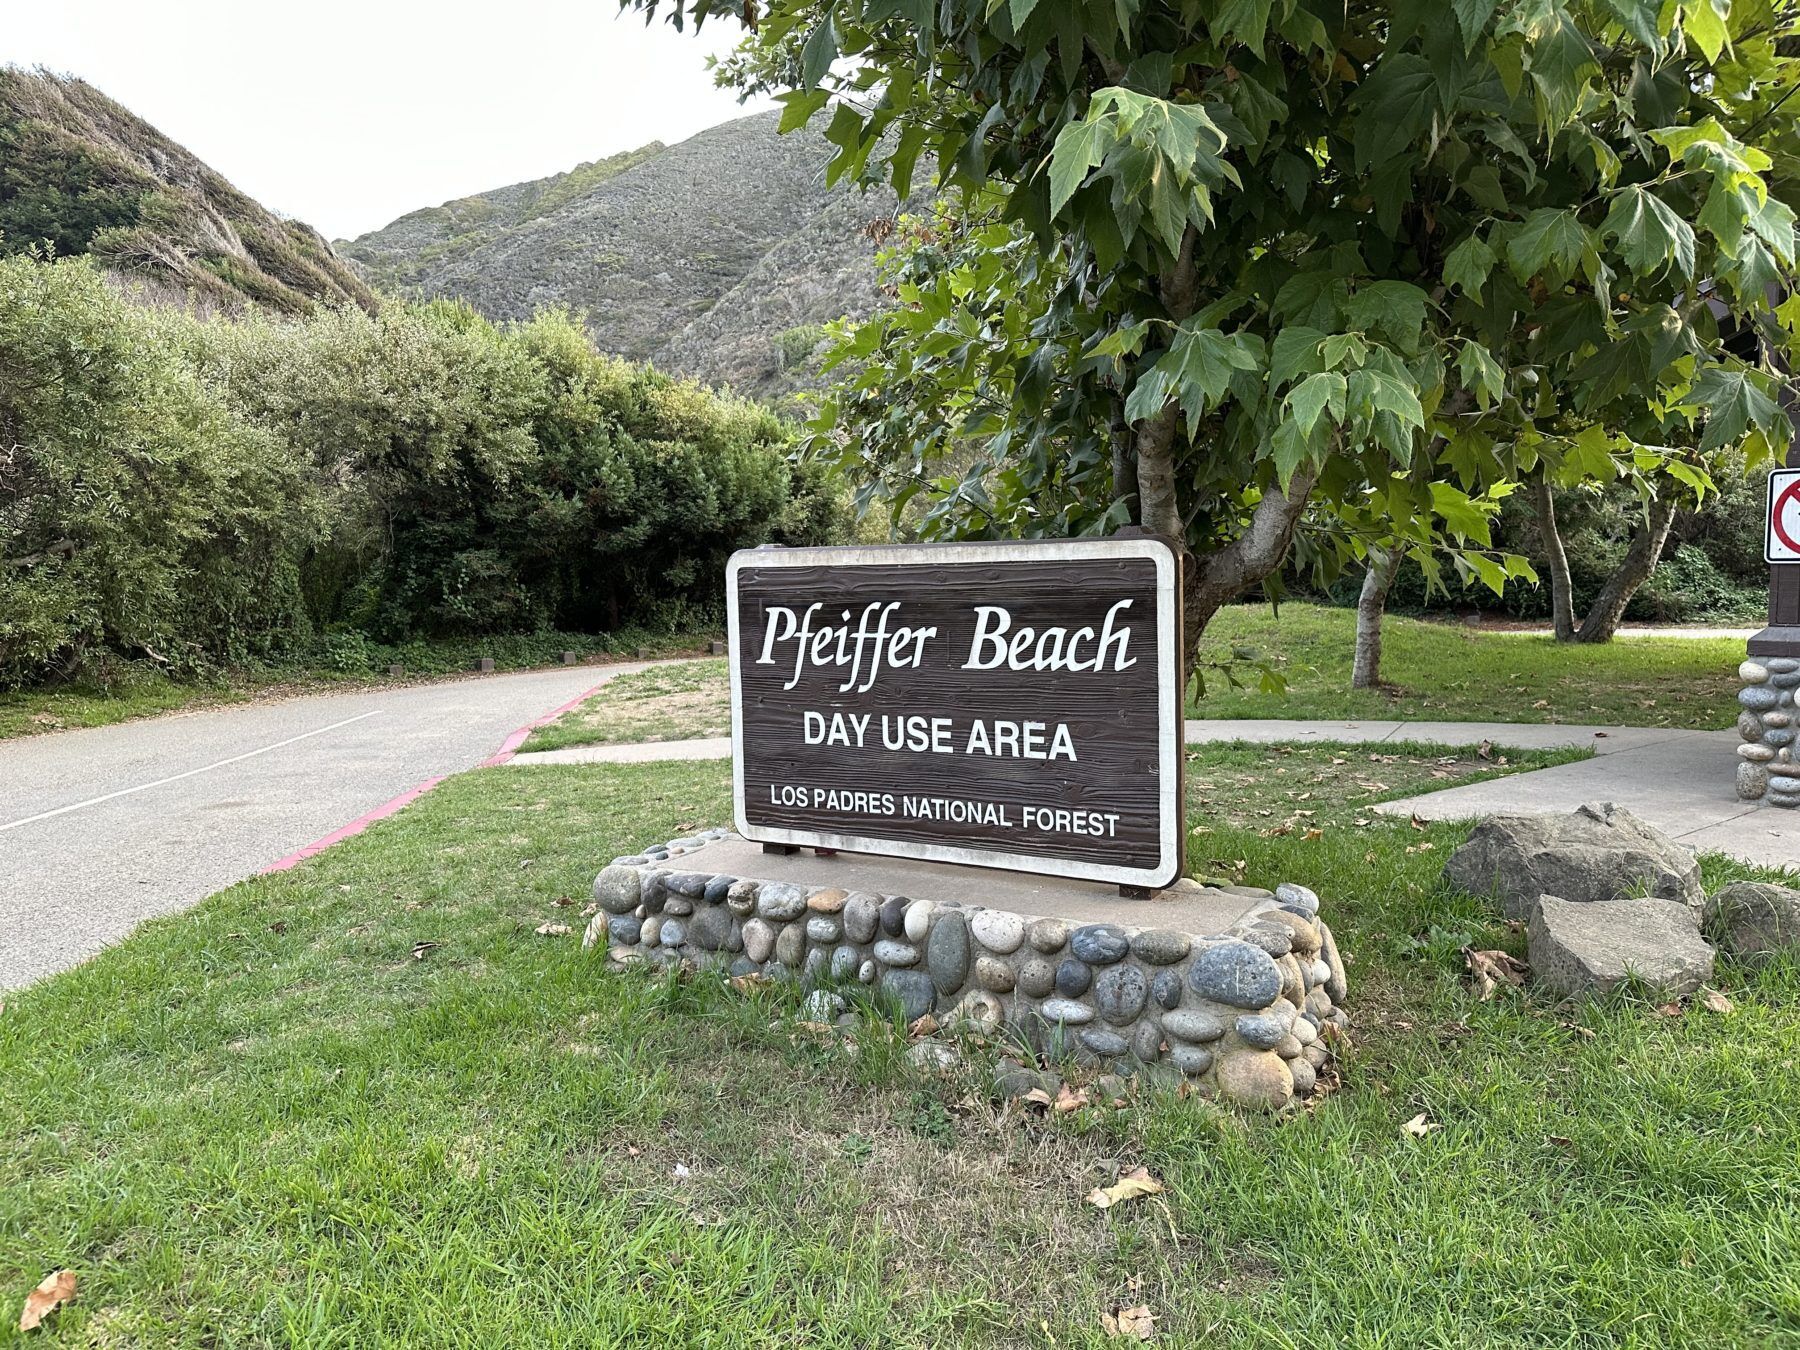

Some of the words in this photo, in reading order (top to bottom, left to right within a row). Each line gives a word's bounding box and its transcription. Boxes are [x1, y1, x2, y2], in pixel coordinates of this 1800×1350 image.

[756, 602, 937, 693] Pfeiffer
[961, 599, 1137, 673] Beach
[803, 711, 872, 748] DAY
[881, 715, 954, 754] USE
[965, 719, 1078, 762] AREA
[770, 784, 809, 808] LOS
[813, 788, 896, 816] PADRES
[902, 795, 1013, 827] NATIONAL
[1022, 806, 1120, 837] FOREST
